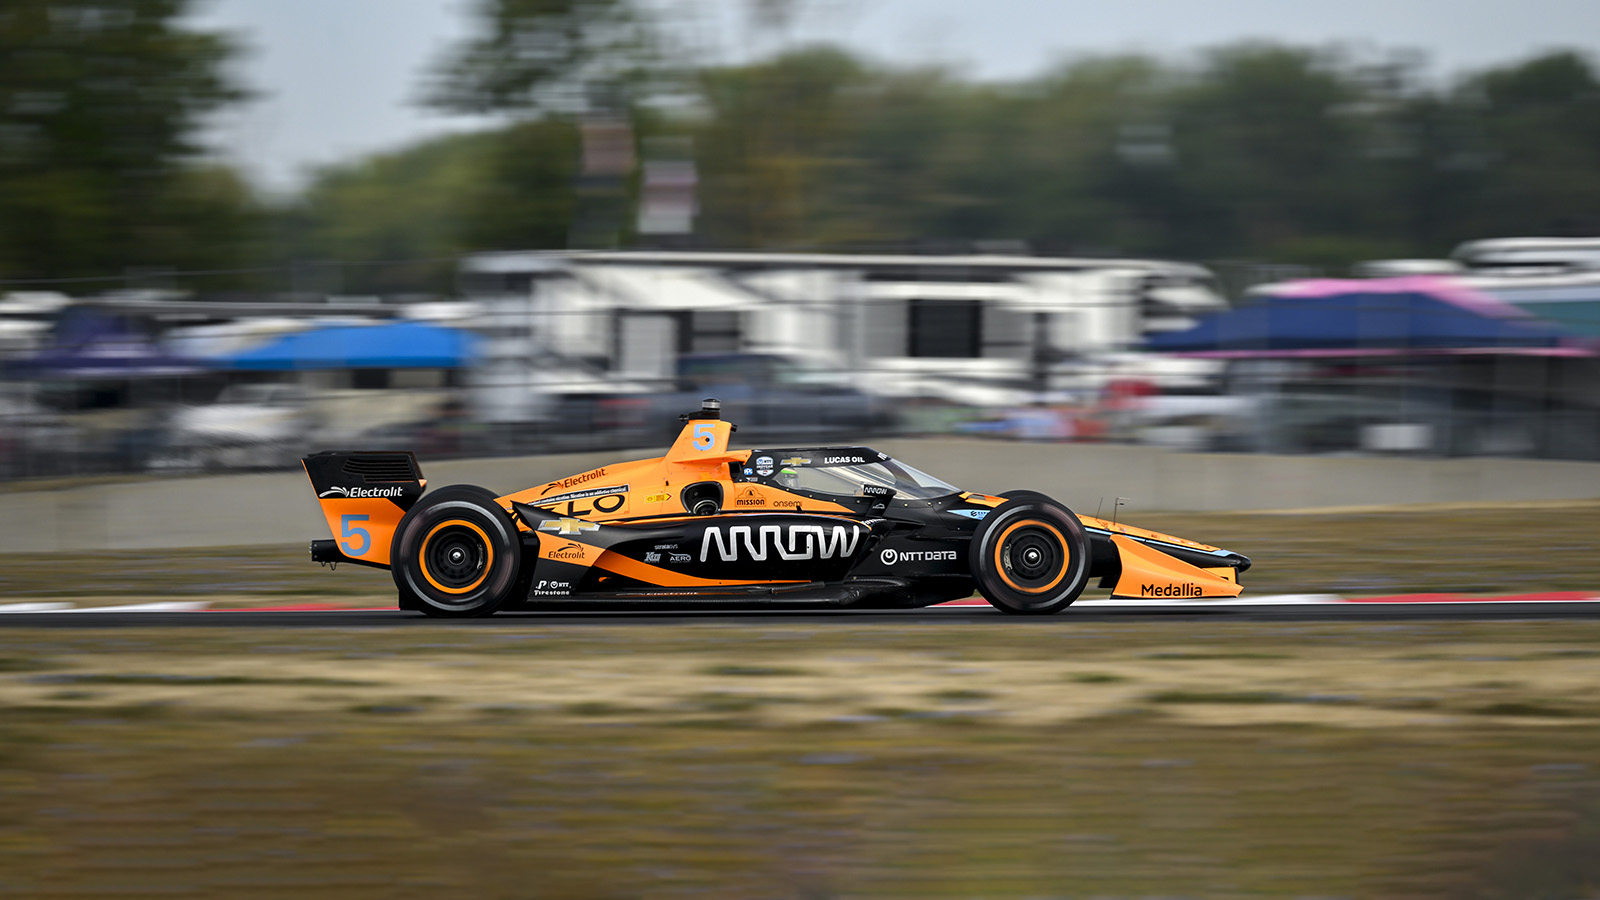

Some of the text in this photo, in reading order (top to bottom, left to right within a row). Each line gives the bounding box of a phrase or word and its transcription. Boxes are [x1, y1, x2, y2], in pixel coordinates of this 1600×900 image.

[692, 424, 715, 450] 5
[824, 456, 850, 464] LUCAS
[564, 468, 606, 488] Electrolit
[350, 486, 403, 498] Electrolit
[340, 514, 371, 557] 5
[700, 525, 860, 562] ARROW
[548, 550, 585, 559] Electrolit
[899, 551, 957, 561] NTT DATA
[1141, 582, 1203, 597] Medallia
